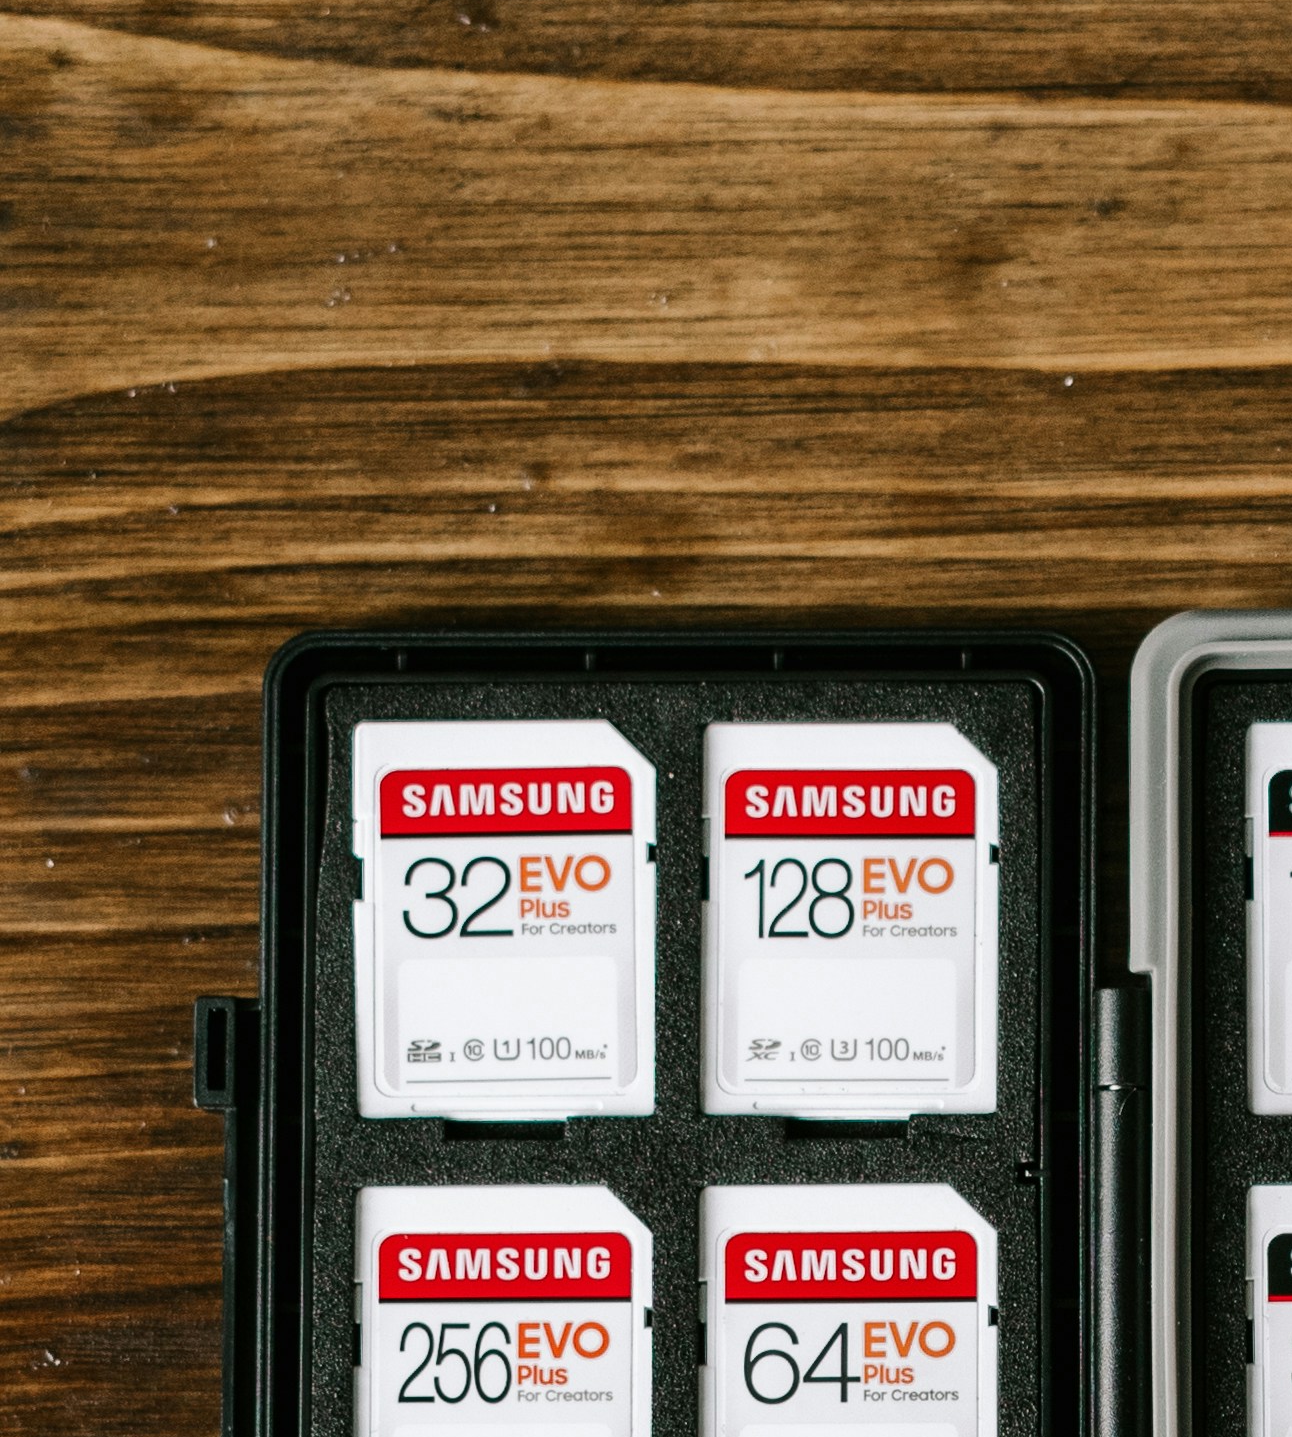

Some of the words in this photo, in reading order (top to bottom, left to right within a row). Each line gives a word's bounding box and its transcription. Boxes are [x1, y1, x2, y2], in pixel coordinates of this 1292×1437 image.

[402, 780, 615, 818] SAMSUNG
[745, 784, 956, 819] SAMSUNG
[402, 856, 514, 940] 32
[519, 854, 612, 893] EVO
[519, 897, 571, 919] Plus
[744, 857, 855, 940] 128
[862, 857, 955, 895] EVO
[862, 899, 913, 921] Plus
[521, 922, 546, 936] For
[548, 921, 618, 936] Creators
[862, 924, 887, 938] For
[889, 924, 958, 938] Creators
[526, 1036, 572, 1061] 100
[865, 1037, 910, 1062] 100
[398, 1246, 611, 1282] SAMSUNG
[744, 1247, 957, 1283] SAMSUNG
[398, 1321, 511, 1404] 256
[517, 1321, 611, 1360] EVO
[517, 1364, 569, 1386] Plus
[742, 1322, 861, 1405] 64
[863, 1320, 957, 1359] EVO
[863, 1363, 915, 1385] Plus
[516, 1389, 542, 1403] For
[544, 1389, 614, 1403] Creators
[863, 1388, 888, 1402] For
[890, 1388, 960, 1402] Creators
